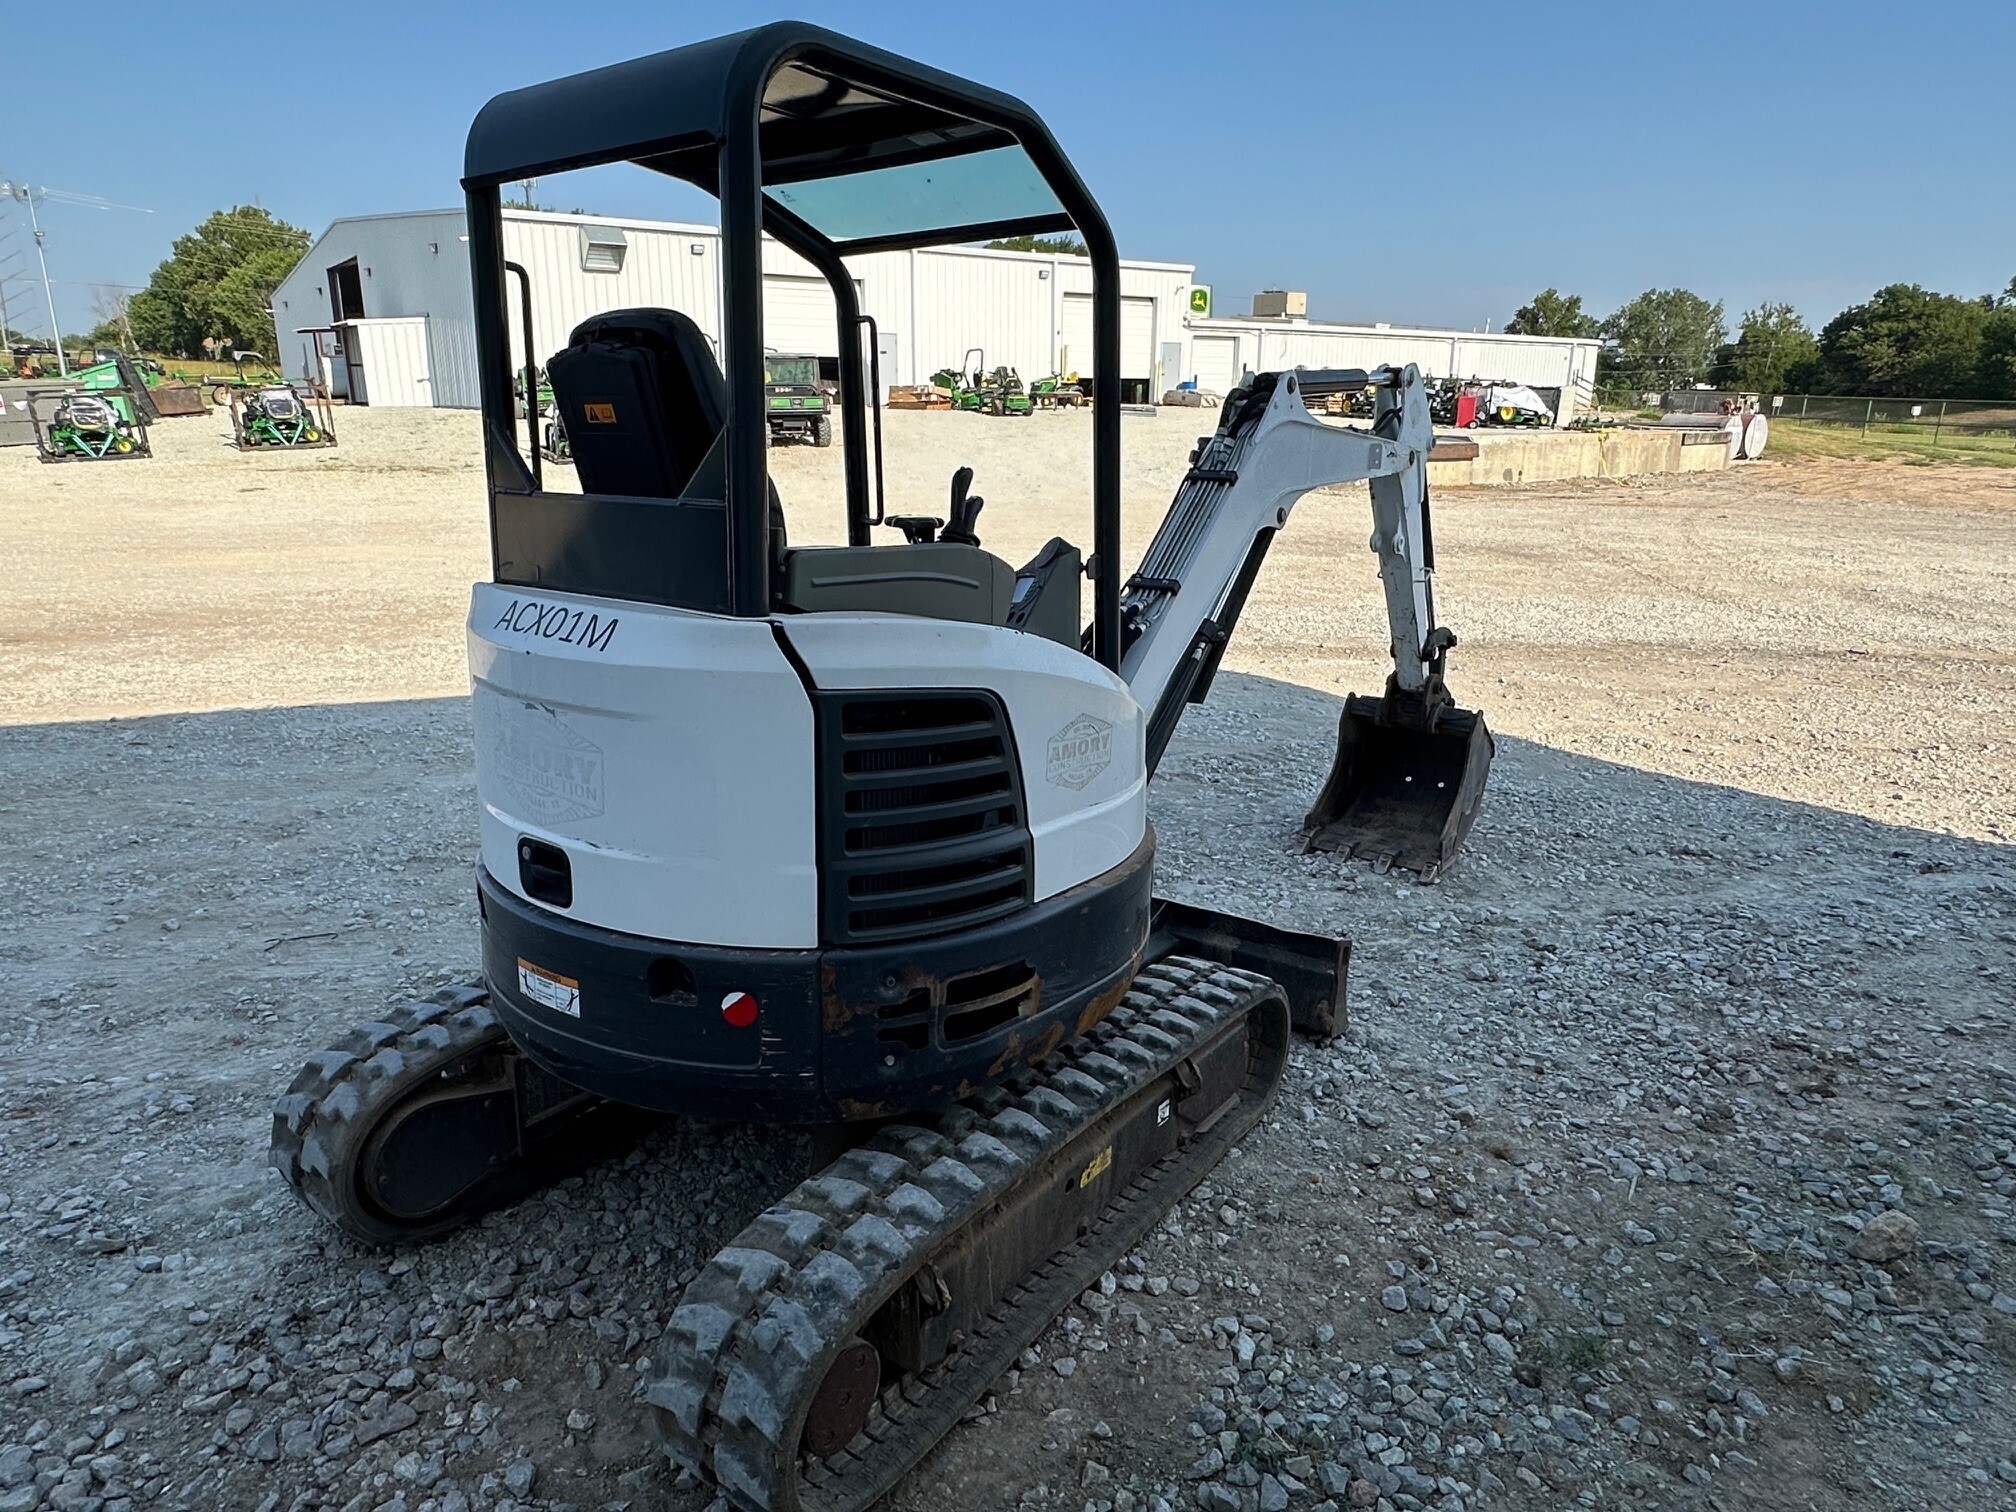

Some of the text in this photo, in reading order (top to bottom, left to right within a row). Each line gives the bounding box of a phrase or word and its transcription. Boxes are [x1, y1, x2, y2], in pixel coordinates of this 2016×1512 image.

[493, 600, 619, 652] ACX01M
[1049, 733, 1110, 764] AMORY
[1049, 749, 1109, 773] CONSTRUCTION
